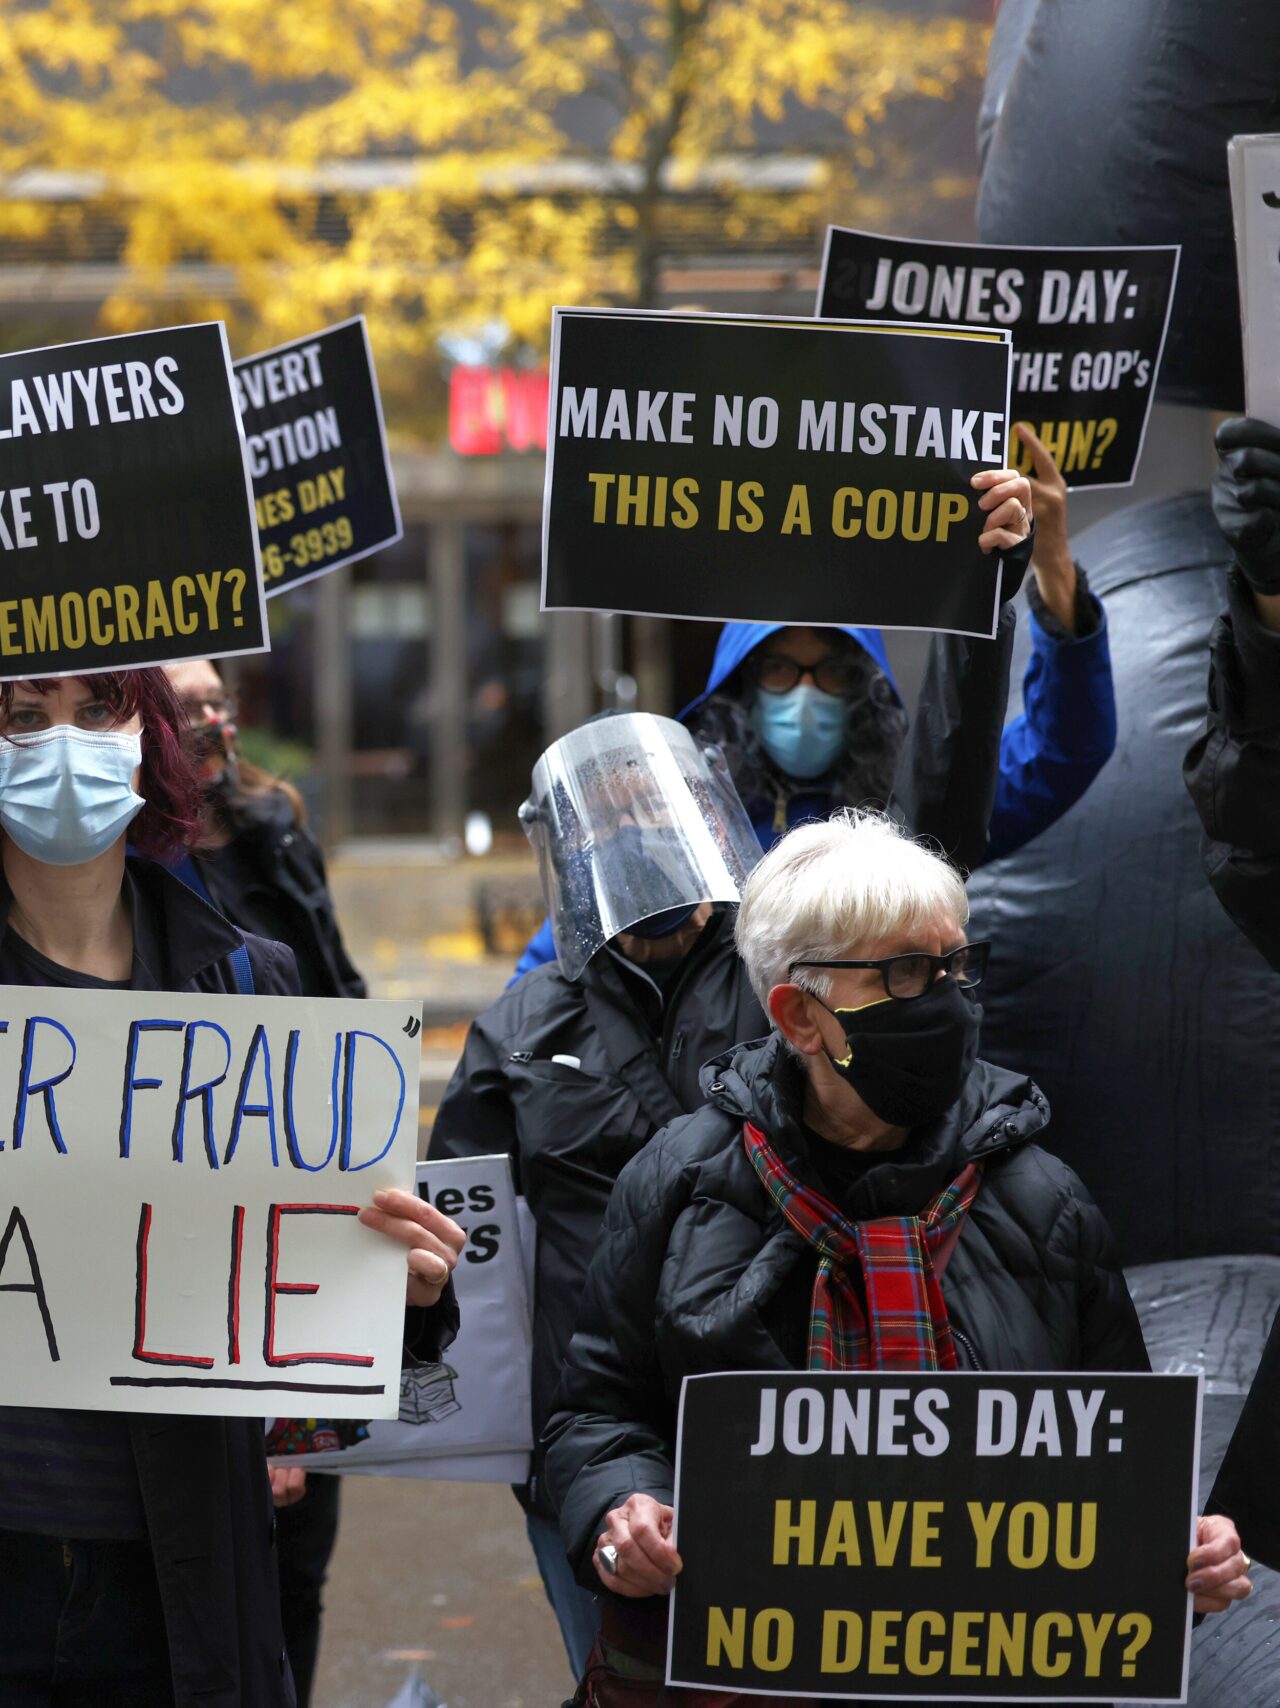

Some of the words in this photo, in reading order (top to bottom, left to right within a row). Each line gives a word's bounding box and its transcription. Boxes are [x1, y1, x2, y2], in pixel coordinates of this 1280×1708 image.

[866, 257, 1024, 324] JONES
[1038, 269, 1138, 325] DAY:
[1070, 350, 1150, 392] GOP's
[559, 386, 696, 444] MAKE
[712, 394, 779, 449] NO
[798, 400, 1005, 463] MISTAKE
[42, 478, 100, 544] TO
[297, 466, 346, 514] DAY
[588, 472, 699, 530] THIS
[718, 480, 764, 534] IS
[780, 484, 813, 536] A
[831, 486, 969, 542] COUP
[131, 1202, 375, 1369] LIE
[750, 1388, 950, 1457] JONES
[976, 1389, 1123, 1457] DAY:
[772, 1499, 944, 1568] HAVE
[967, 1501, 1097, 1570] YOU
[706, 1606, 795, 1672] NO
[820, 1609, 1153, 1678] DECENCY?
